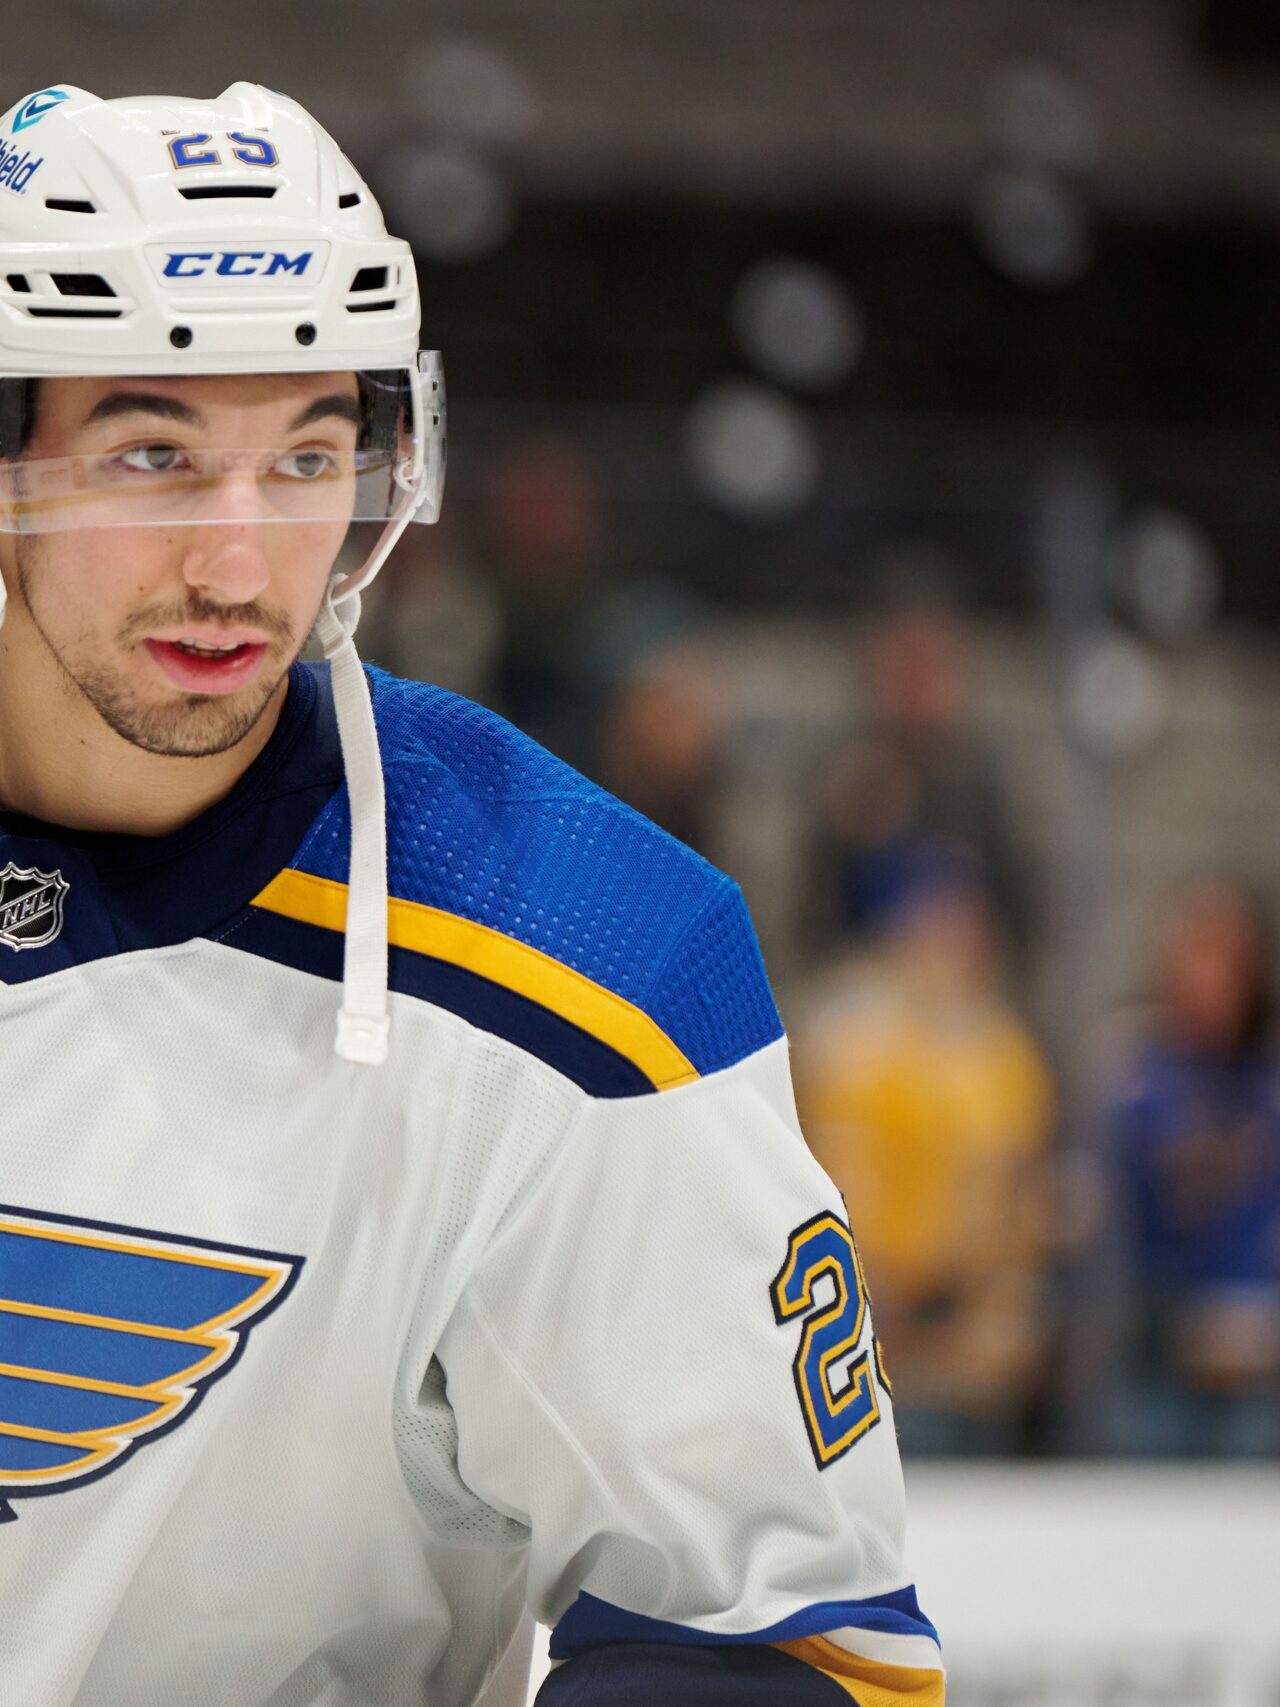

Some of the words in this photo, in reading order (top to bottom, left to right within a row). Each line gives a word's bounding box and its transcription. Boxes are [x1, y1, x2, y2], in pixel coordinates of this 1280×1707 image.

[161, 128, 280, 170] 25
[163, 252, 314, 278] CCM
[2, 889, 51, 929] NHL
[769, 1206, 893, 1473] 2
